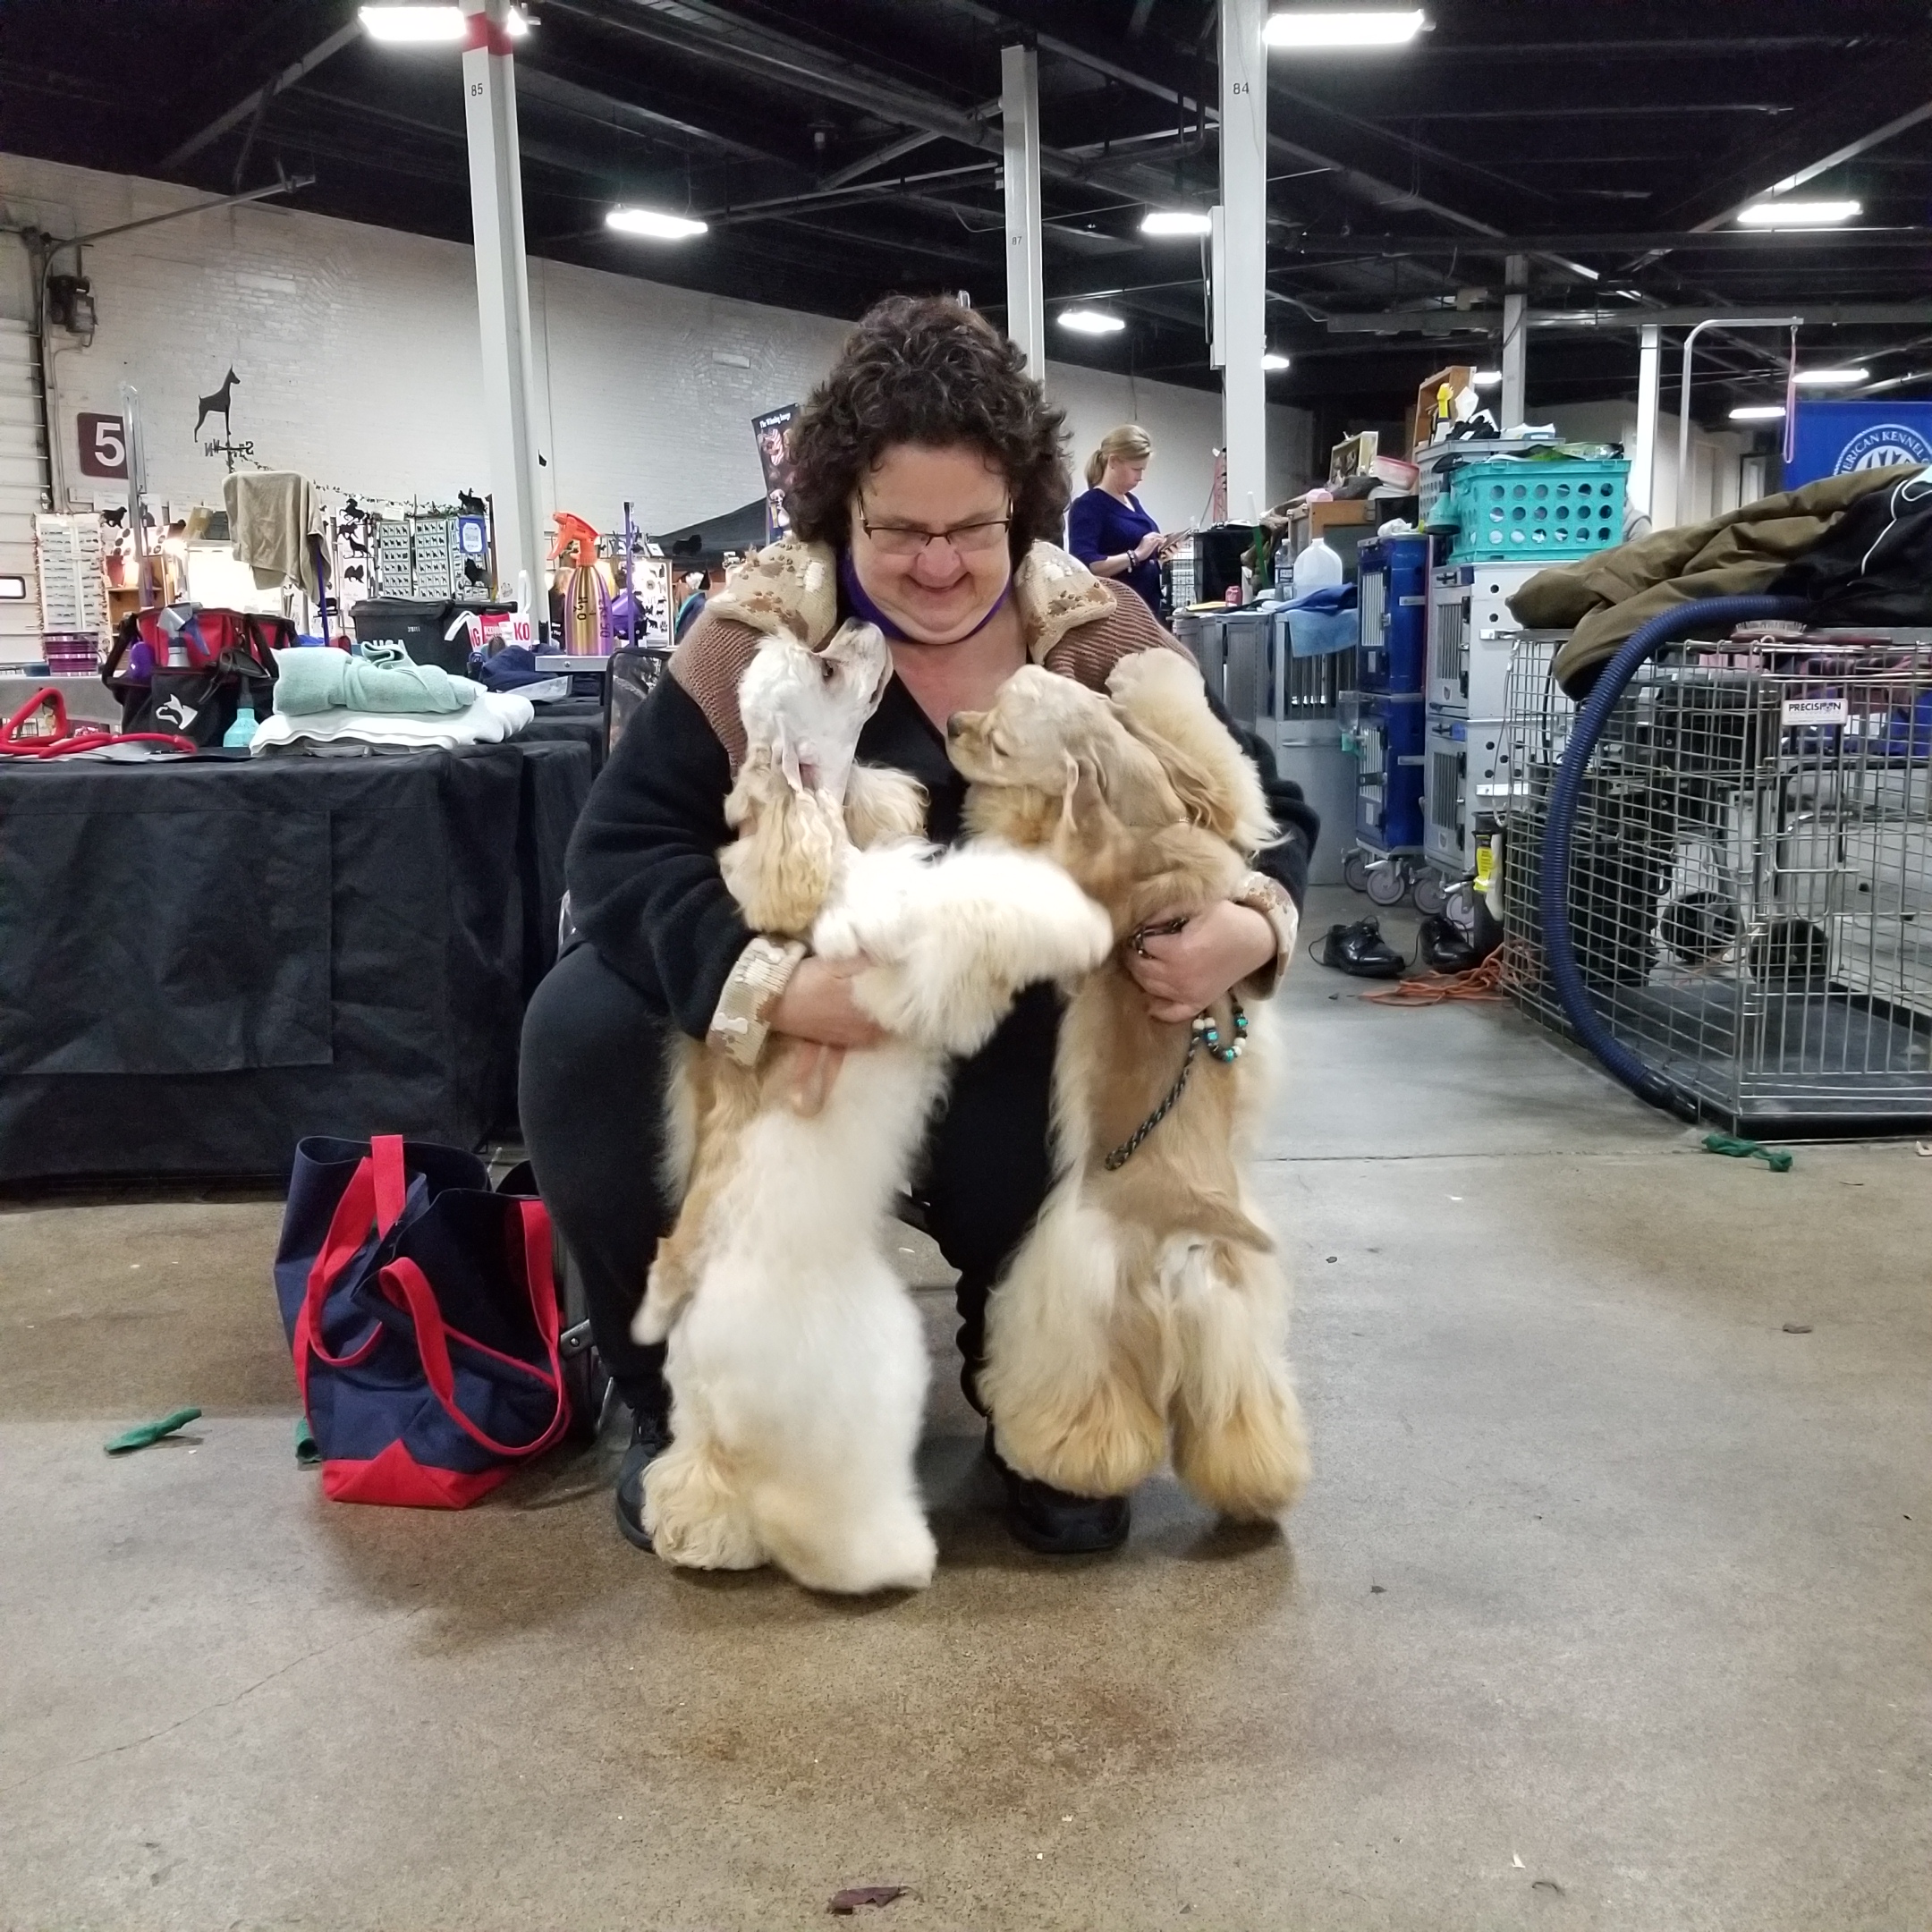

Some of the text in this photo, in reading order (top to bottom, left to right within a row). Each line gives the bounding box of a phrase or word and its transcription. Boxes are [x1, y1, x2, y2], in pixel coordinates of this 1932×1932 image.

[470, 82, 483, 97] 85
[1233, 81, 1250, 95] 84
[1012, 235, 1022, 245] 87
[95, 421, 125, 467] 5
[1841, 433, 1879, 474] ERICAN
[1882, 430, 1924, 458] KENNEL
